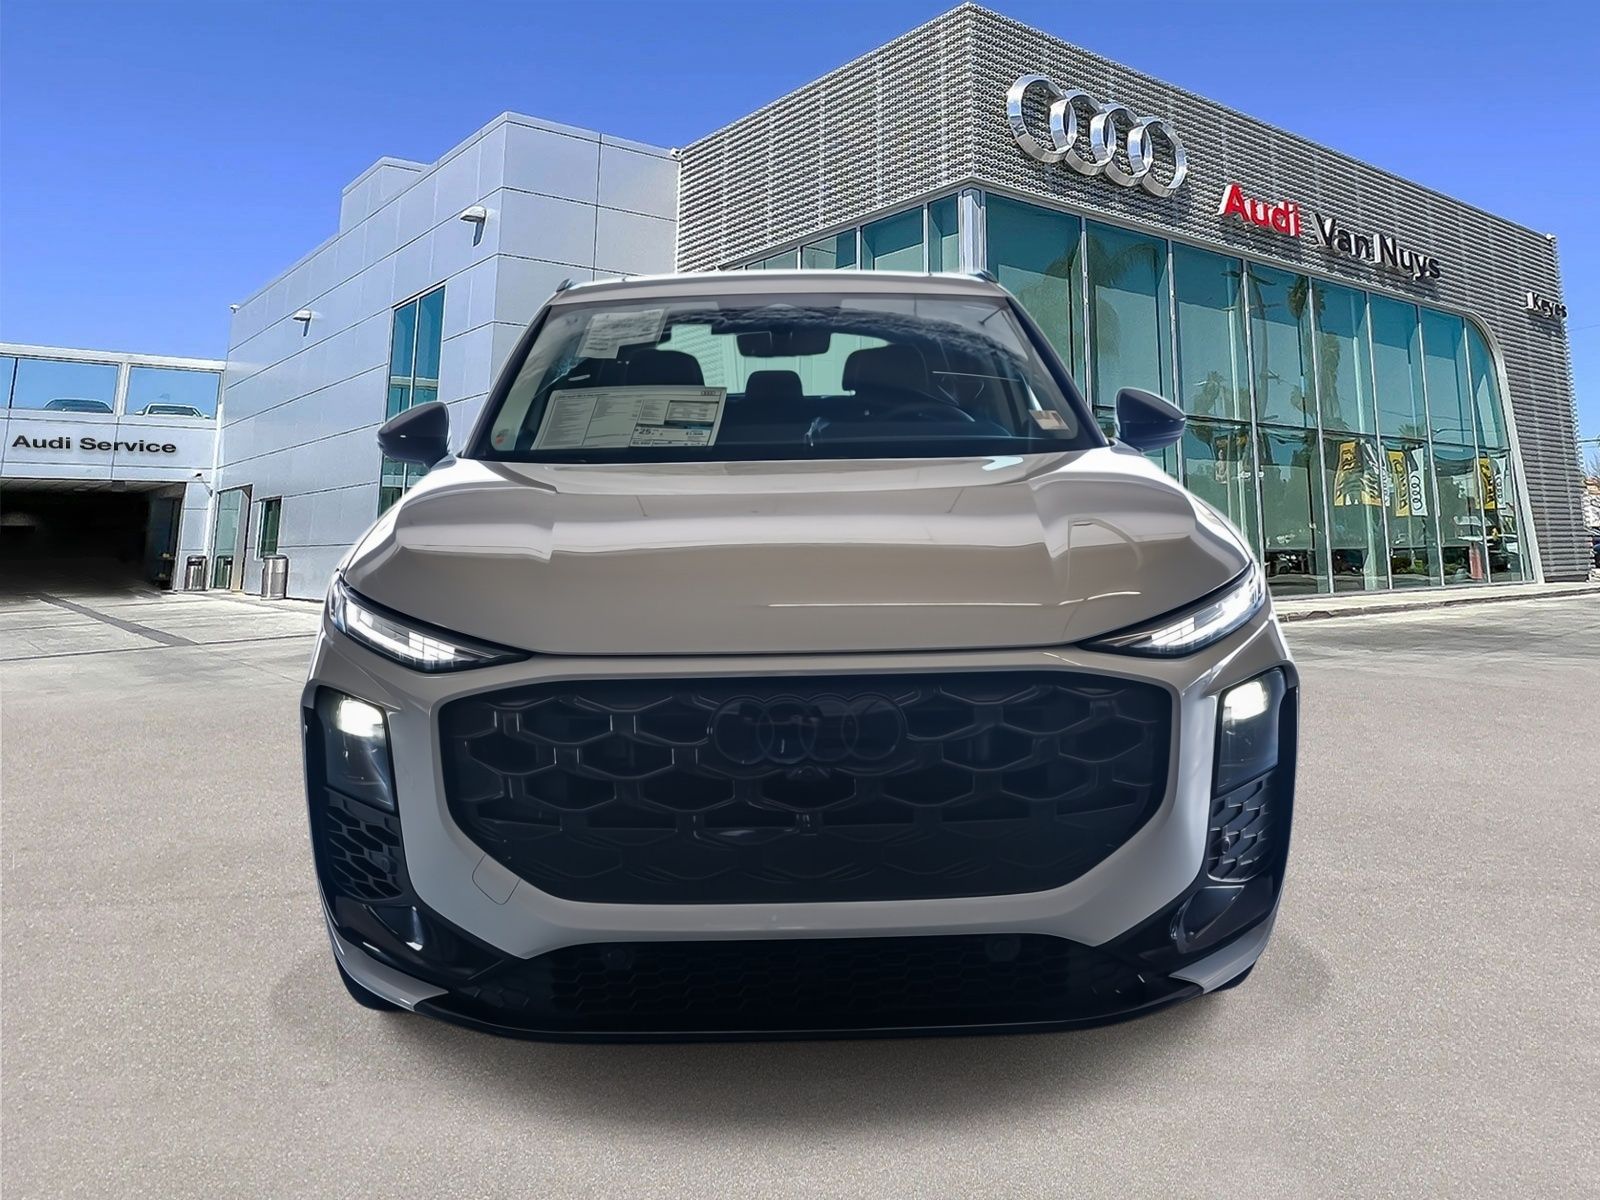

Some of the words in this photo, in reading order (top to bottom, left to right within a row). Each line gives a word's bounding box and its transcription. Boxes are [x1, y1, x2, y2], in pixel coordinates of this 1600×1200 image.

[1217, 183, 1301, 238] Audi
[1311, 212, 1369, 259] Van
[1374, 233, 1440, 280] Nuys
[1527, 292, 1567, 318] Keyes
[12, 435, 71, 450] Audi
[79, 437, 177, 453] Service
